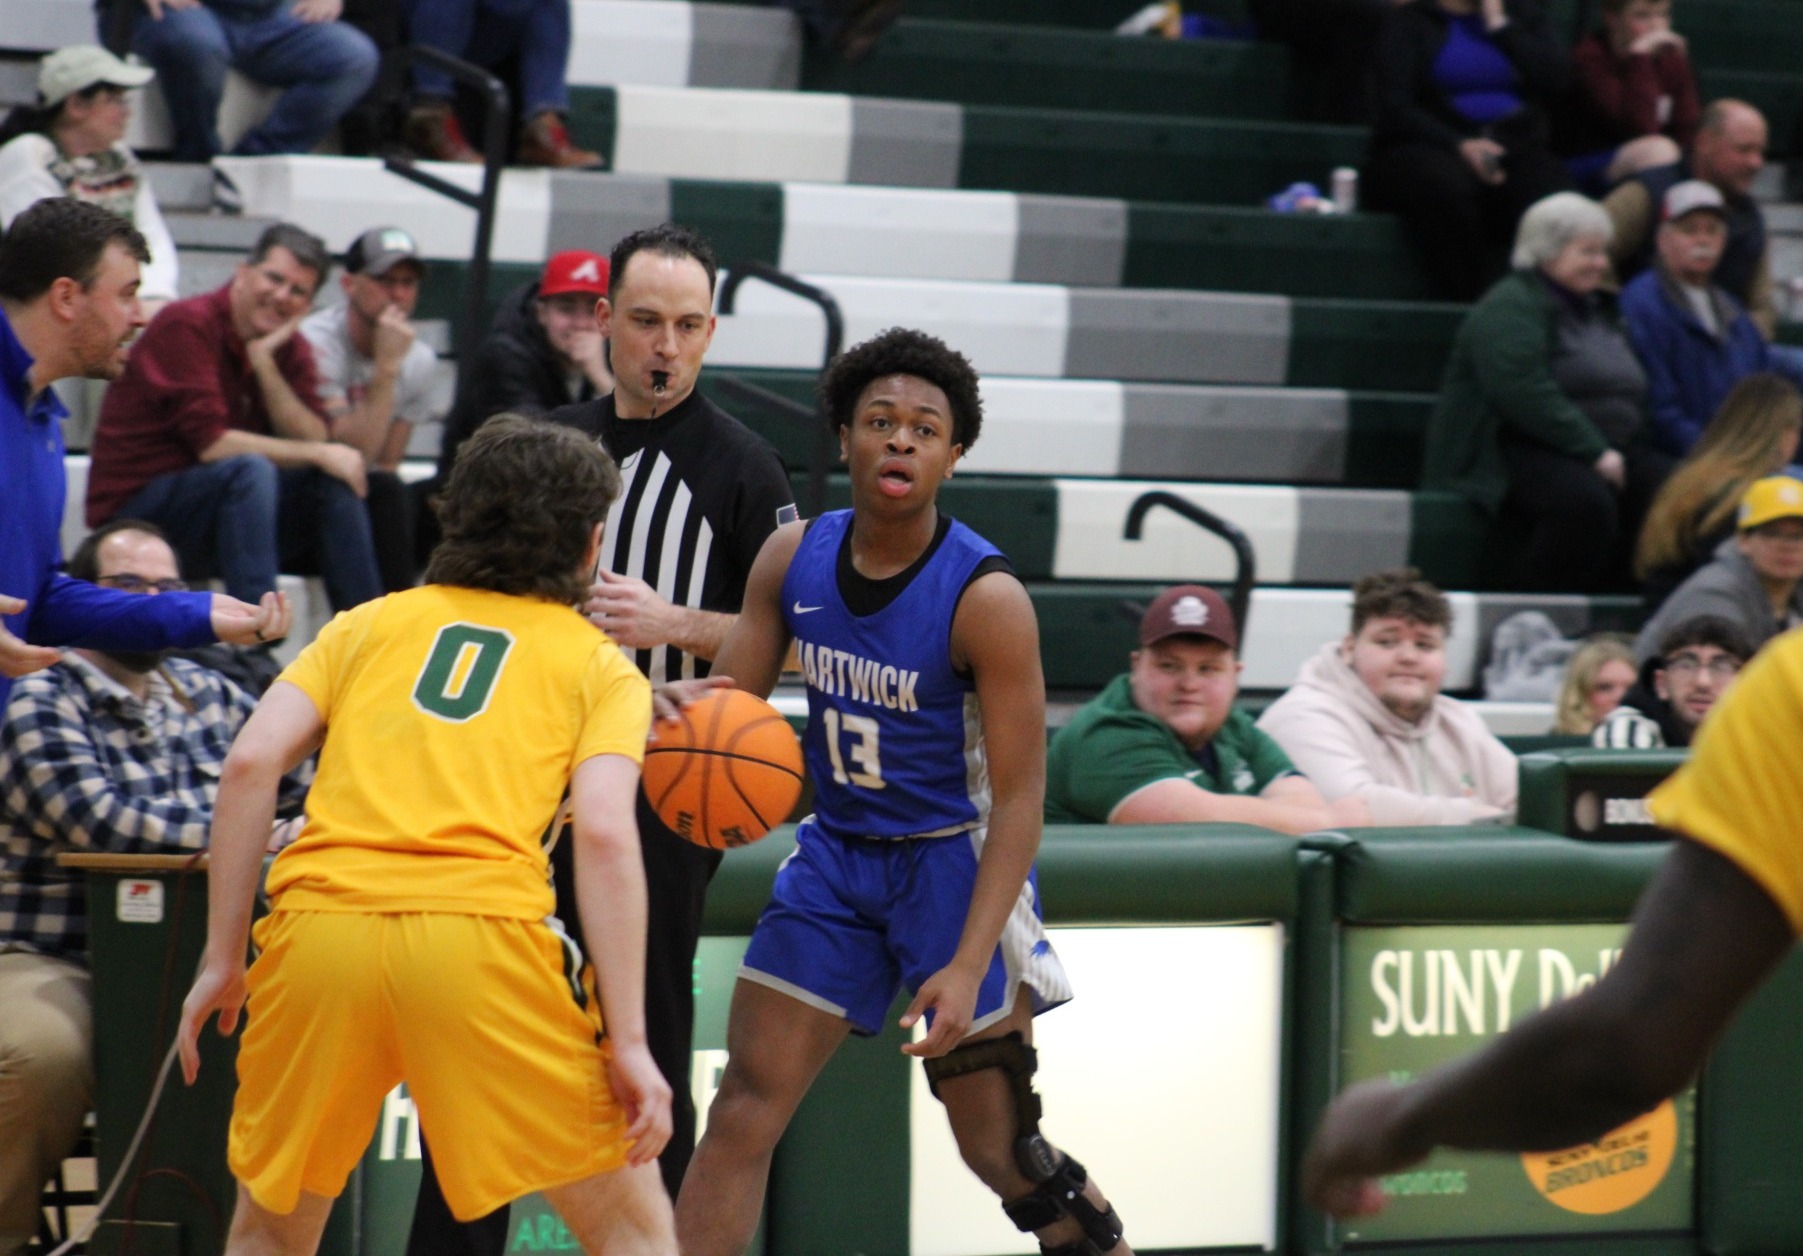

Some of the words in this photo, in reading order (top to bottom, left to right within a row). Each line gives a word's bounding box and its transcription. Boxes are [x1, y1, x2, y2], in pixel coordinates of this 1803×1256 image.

[410, 620, 517, 723] 0
[823, 707, 887, 790] 13
[1604, 798, 1655, 825] BONU
[1371, 949, 1523, 1036] SUNY
